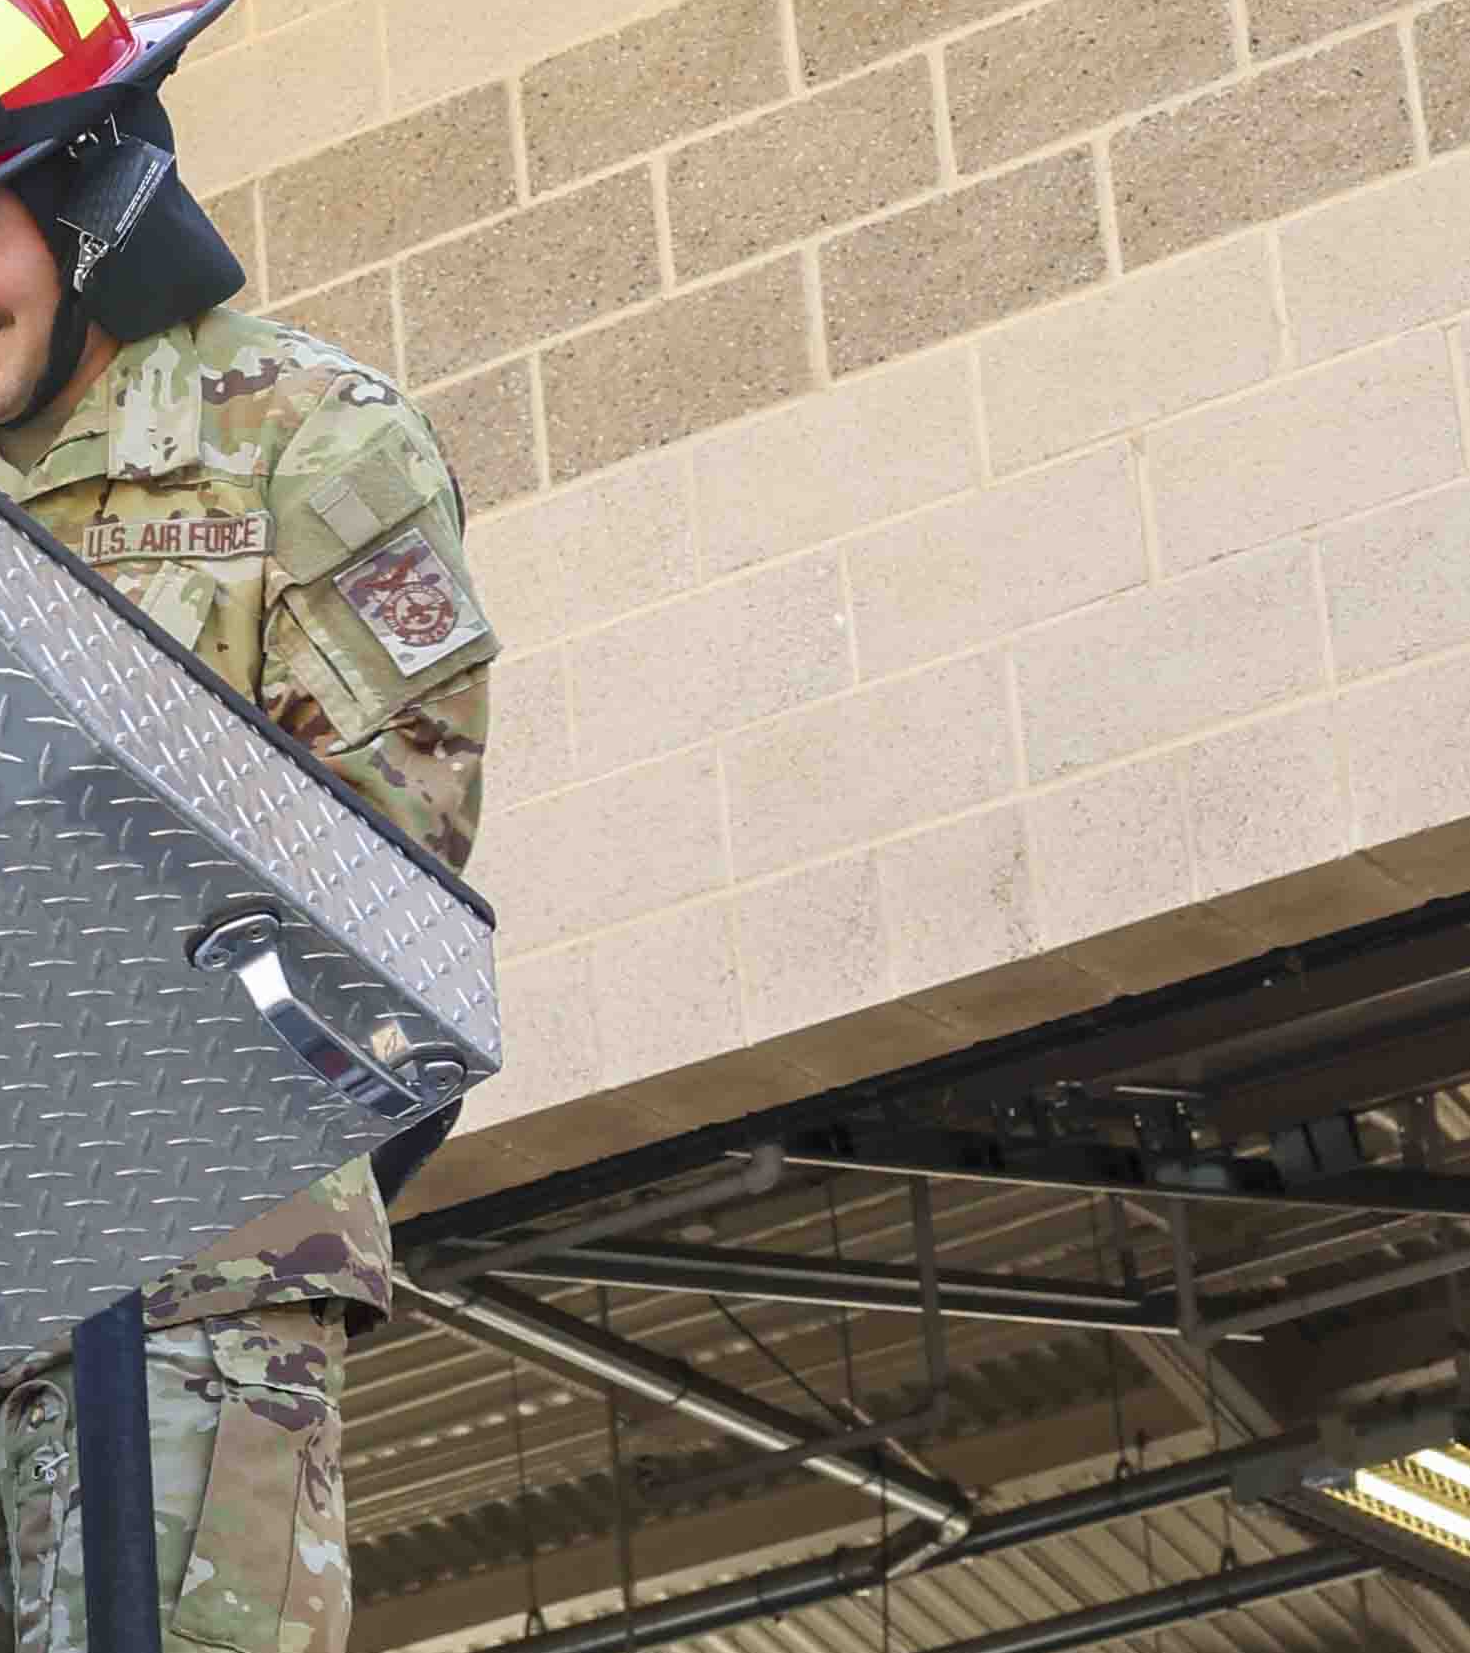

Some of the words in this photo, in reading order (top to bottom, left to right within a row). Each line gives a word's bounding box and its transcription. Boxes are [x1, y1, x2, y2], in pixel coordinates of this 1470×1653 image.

[86, 524, 130, 558] U.S.
[140, 521, 182, 553] AIR
[188, 516, 260, 553] FORCE
